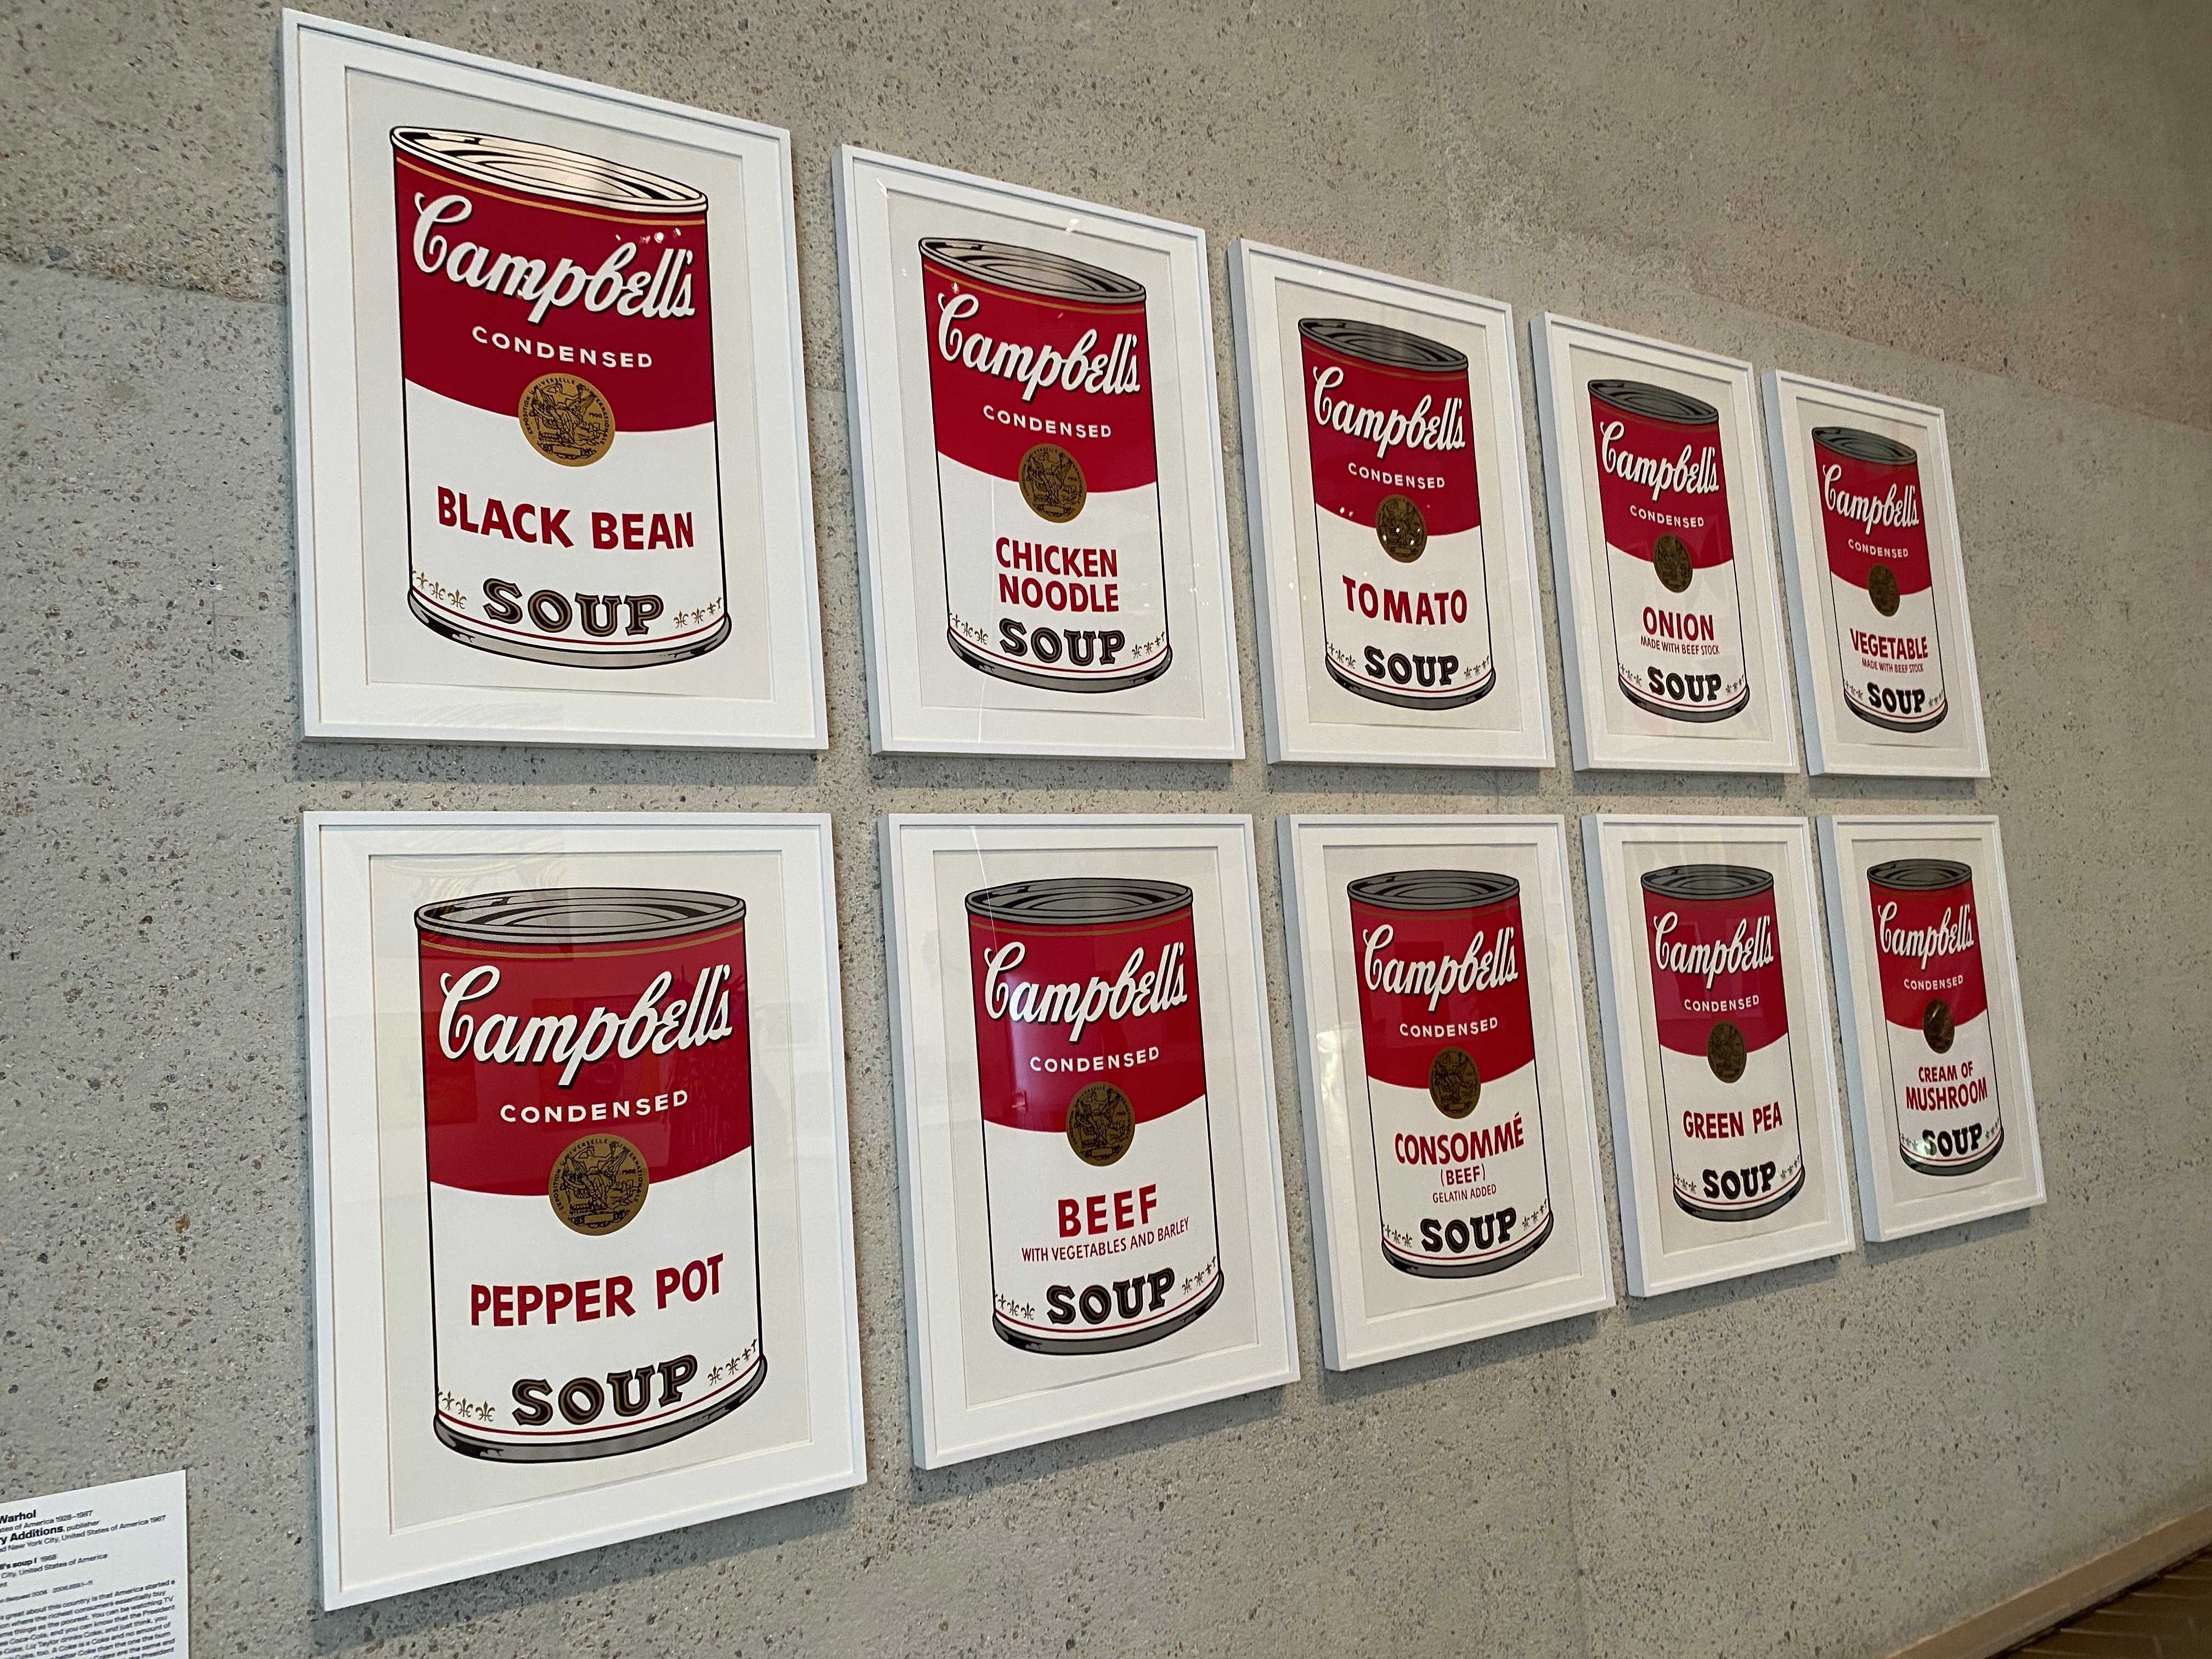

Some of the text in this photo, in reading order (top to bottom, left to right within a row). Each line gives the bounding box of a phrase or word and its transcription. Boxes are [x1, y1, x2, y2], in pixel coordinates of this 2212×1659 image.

[413, 193, 696, 323] Campbell's
[472, 326, 652, 367] CONDENSED
[938, 294, 1141, 400] Campbell's
[522, 396, 533, 435] EXPOSITION
[984, 405, 1111, 438] CONDENSED
[1313, 366, 1465, 458] Campbell's
[1348, 463, 1444, 489] CONDENSED
[1600, 421, 1719, 501] Campbell's
[1630, 505, 1703, 528] CONDENSED
[1822, 464, 1919, 535] Campbell's
[438, 487, 693, 550] BLACK BEAN
[996, 537, 1118, 578] CHICKEN
[1848, 539, 1908, 558] CONDENSED
[482, 578, 664, 636] SOUP
[999, 574, 1119, 612] NOODLE
[1342, 576, 1467, 625] TOMATO
[999, 618, 1125, 665] SOUP
[1643, 607, 1714, 641] ONION
[1641, 636, 1719, 654] MADE WITH BEEF STOCK
[1850, 628, 1928, 659] VEGETABLE
[1363, 645, 1459, 686] SOUP
[1862, 658, 1923, 673] MADE WITH BEEF STOCK
[1647, 667, 1720, 702] SOUP
[1867, 683, 1925, 714] SOUP
[1654, 912, 1774, 989] Campbell's
[1878, 902, 1974, 969] Campbell's
[1363, 924, 1518, 1011] Campbell's
[1904, 975, 1963, 990] CONDENSED
[984, 942, 1187, 1042] Campbell's
[1685, 995, 1759, 1012] CONDENSED
[439, 964, 732, 1085] Campbell's
[1400, 1017, 1497, 1037] CONDENSED
[1030, 1047, 1159, 1072] CONDENSED
[1918, 1061, 1973, 1082] CREAM OF
[501, 1090, 687, 1123] CONDENSED
[1906, 1077, 1987, 1111] MUSHROOM
[1683, 1102, 1782, 1139] GREEN PEA
[1395, 1113, 1524, 1165] CONSOMMÉ
[1922, 1122, 1983, 1156] SOUP
[552, 1169, 564, 1210] EXPOSITION
[1441, 1164, 1486, 1187] (BEEF)
[1703, 1161, 1776, 1199] SOUP
[1058, 1184, 1157, 1238] BEEF
[1432, 1184, 1497, 1203] GELATIN ADDED
[1022, 1216, 1189, 1260] WITH VEGETABLES AND BARLEY
[1420, 1207, 1517, 1252] SOUP
[471, 1254, 723, 1327] PEPPER POT
[1046, 1267, 1175, 1324] SOUP
[512, 1355, 697, 1426] SOUP
[0, 1509, 36, 1523] Warhol
[23, 1519, 54, 1528] America
[61, 1531, 85, 1541] United
[86, 1527, 109, 1536] States
[119, 1520, 148, 1529] America
[66, 1520, 99, 1531] publisher
[19, 1565, 42, 1575] United
[44, 1561, 67, 1570] States
[77, 1554, 107, 1563] America
[5, 1611, 24, 1619] great
[25, 1606, 46, 1615] about
[62, 1598, 90, 1607] country
[114, 1587, 143, 1596] America
[144, 1581, 169, 1590] started
[11, 1618, 33, 1626] where
[48, 1610, 72, 1618] richest
[74, 1601, 114, 1613] consumers
[115, 1593, 151, 1605] essentially
[14, 1626, 36, 1634] things
[130, 1599, 162, 1610] watching
[142, 1605, 174, 1616] President
[60, 1634, 82, 1642] drinks
[111, 1632, 124, 1640] and
[136, 1624, 162, 1635] amount
[142, 1642, 161, 1650] same
